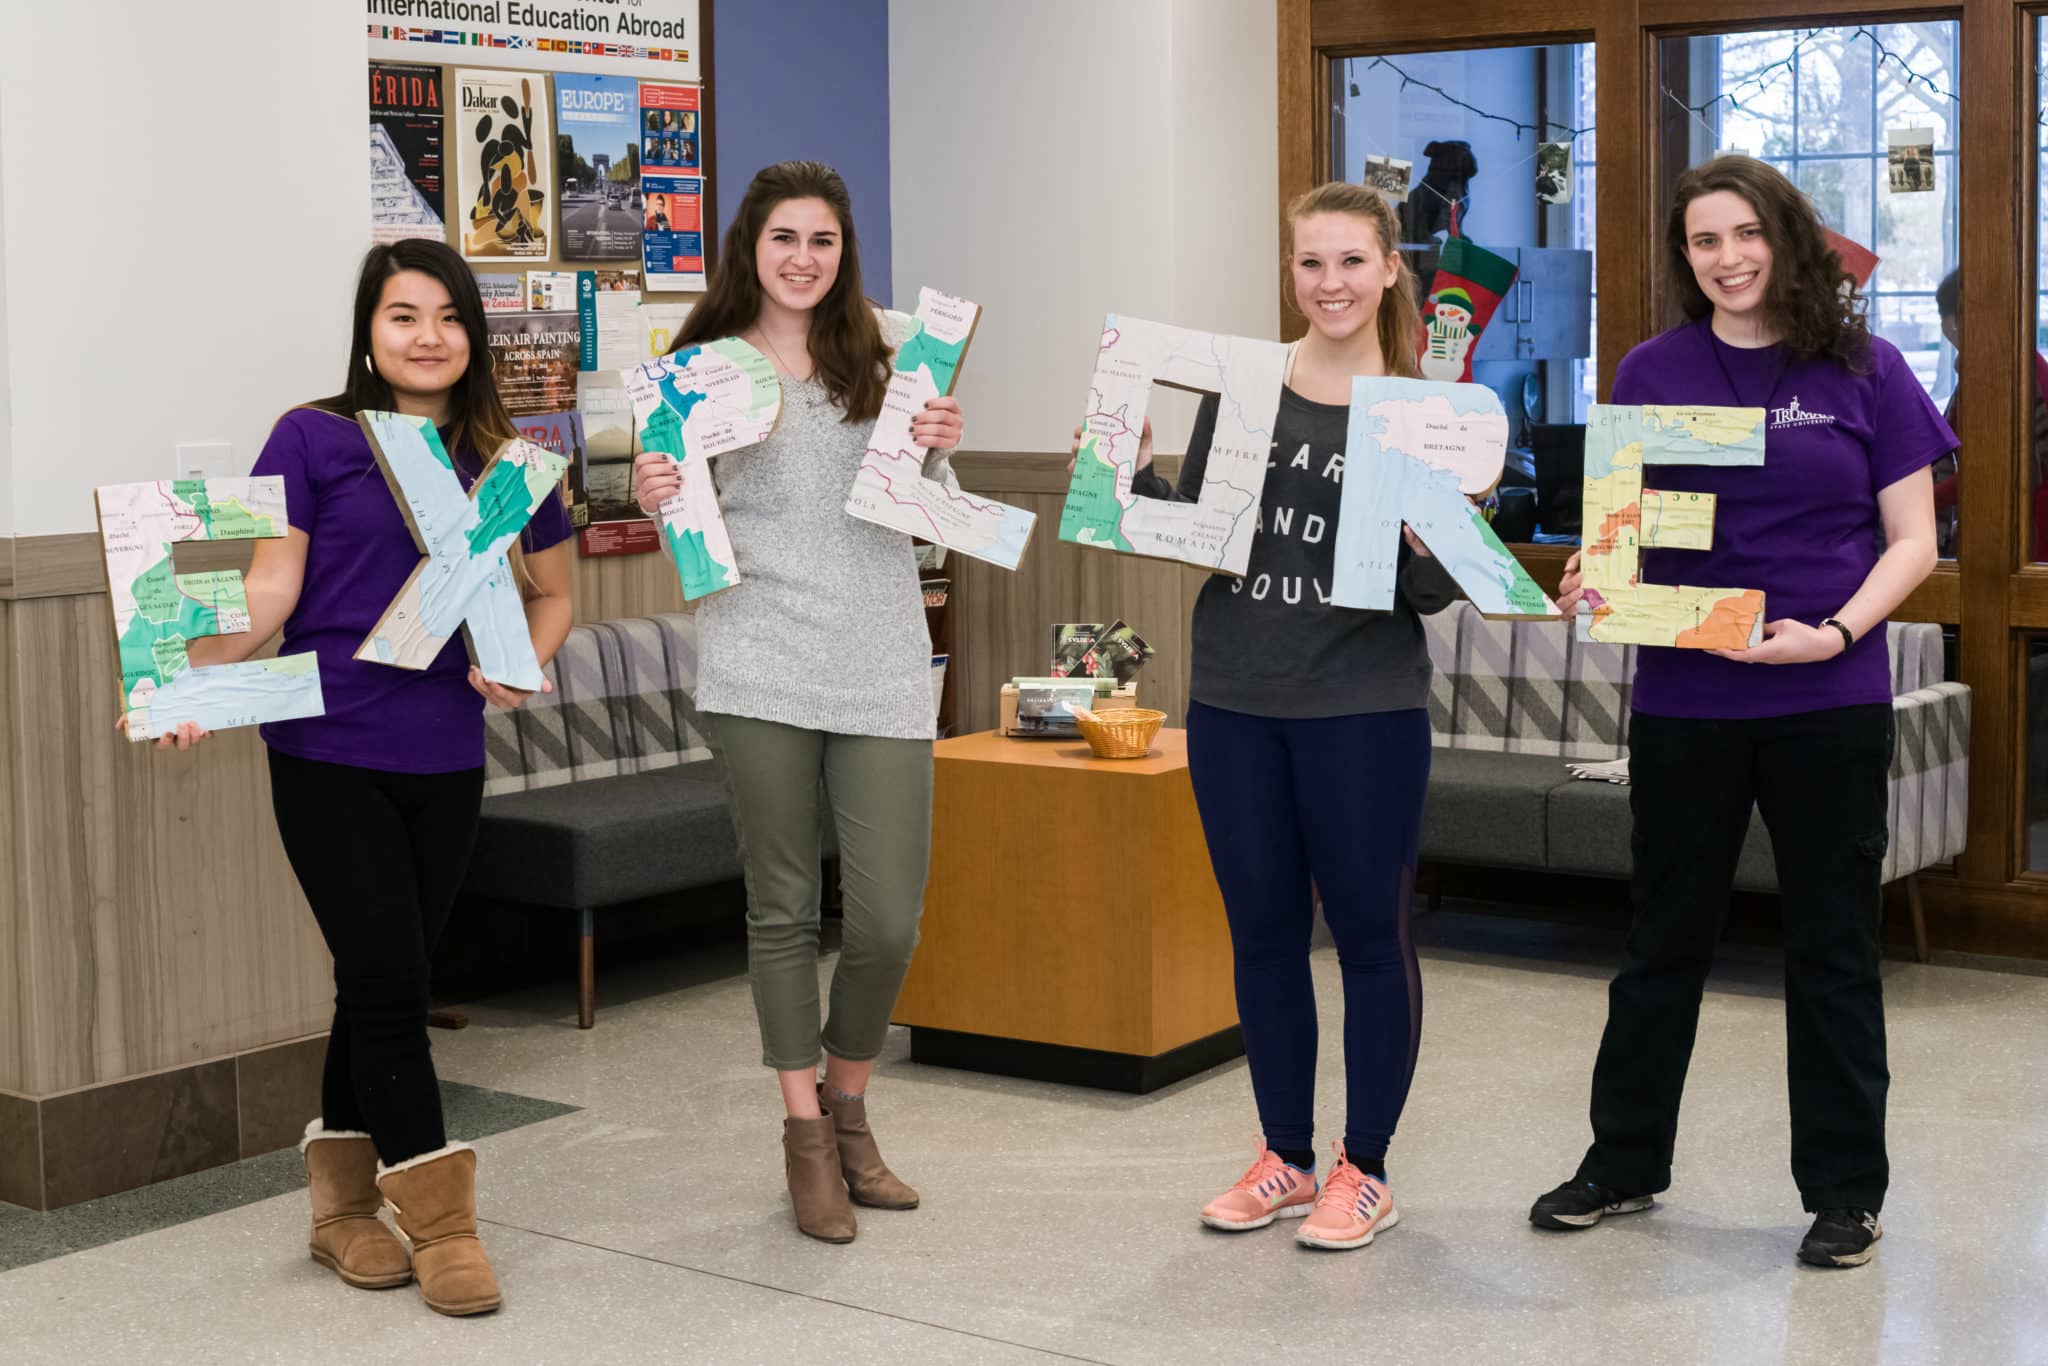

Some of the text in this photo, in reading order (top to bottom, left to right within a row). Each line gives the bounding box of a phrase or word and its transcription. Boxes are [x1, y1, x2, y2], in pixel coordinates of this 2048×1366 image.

[368, 0, 685, 39] International Education Abroad
[373, 69, 438, 107] ÉRIDA
[462, 86, 499, 109] Dakar
[561, 89, 624, 112] EUROPE
[487, 331, 581, 347] LEIN AIR PAINTING
[504, 349, 560, 361] ACROSS SPAIN
[1212, 446, 1259, 461] MPIRE
[1423, 443, 1466, 452] BRETAGNE
[1380, 520, 1434, 529] OCAN
[1155, 532, 1218, 552] ROMAIN
